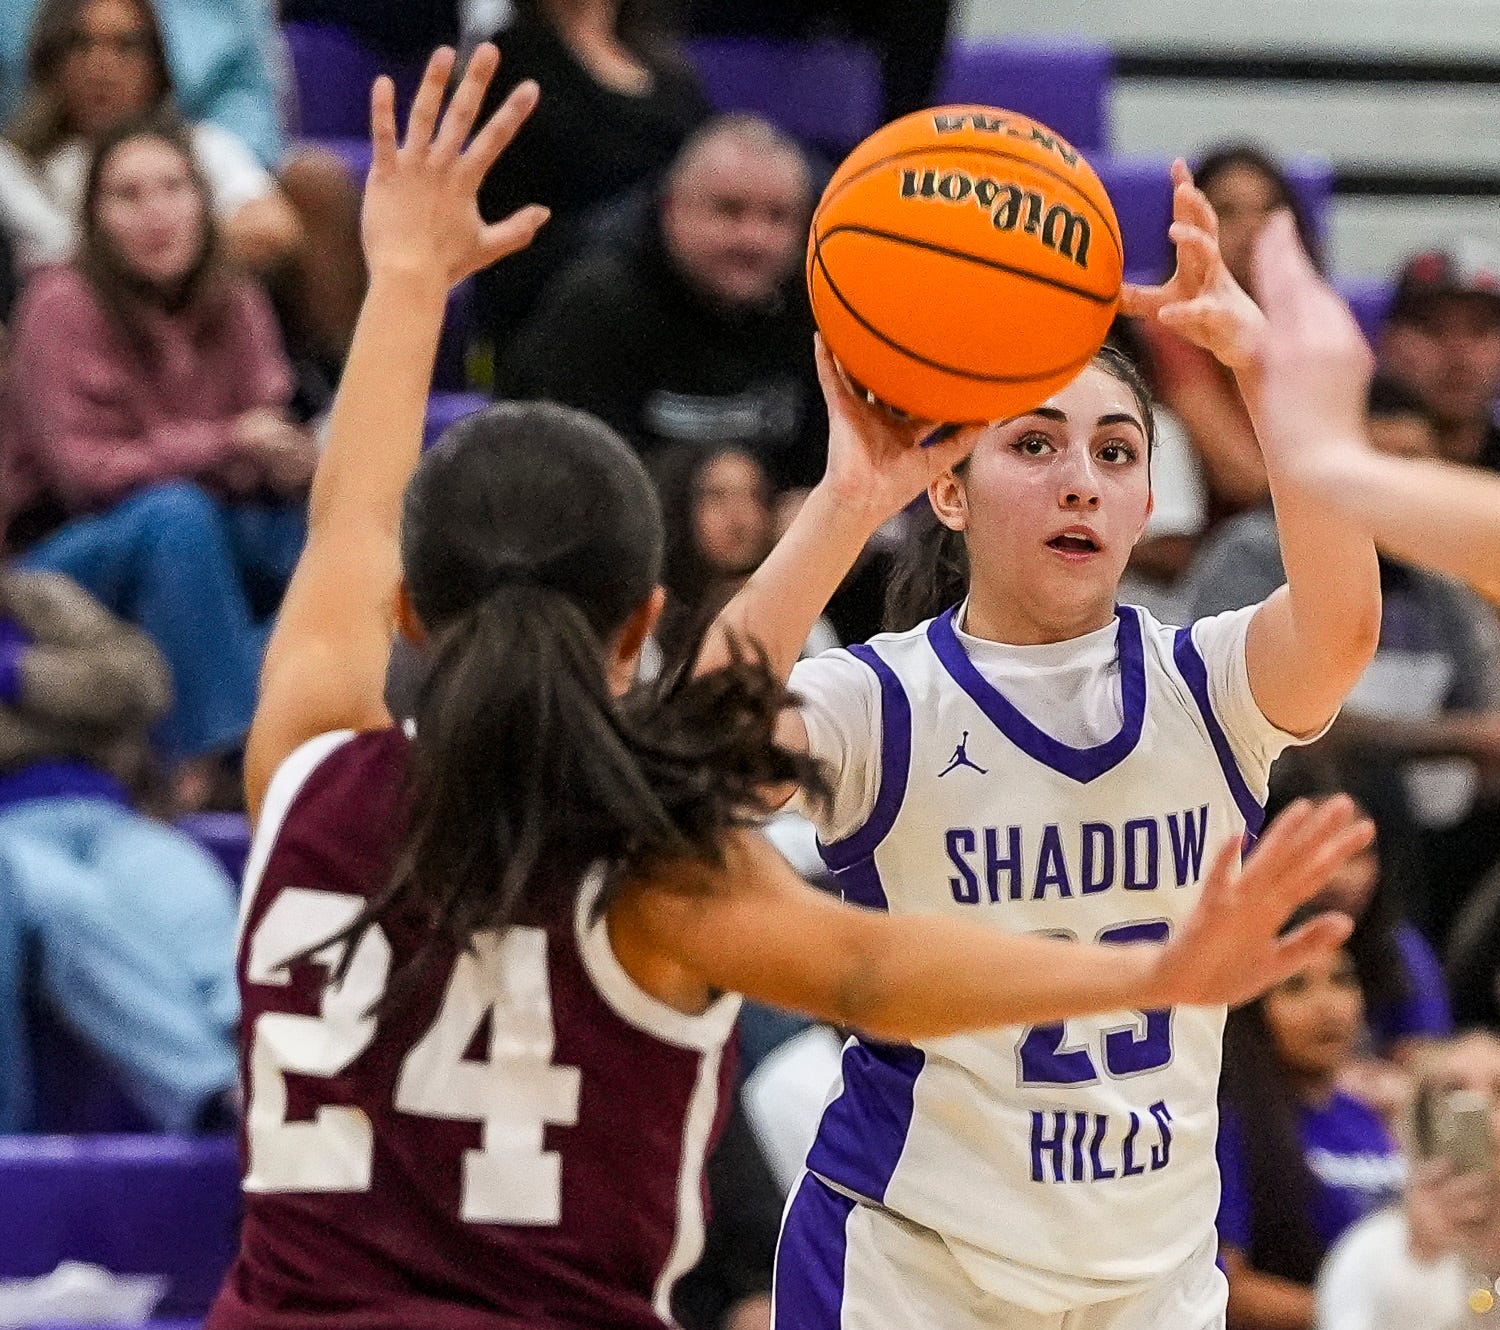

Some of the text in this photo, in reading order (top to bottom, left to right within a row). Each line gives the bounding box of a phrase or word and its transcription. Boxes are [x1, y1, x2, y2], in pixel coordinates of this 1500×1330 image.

[901, 169, 1091, 268] Wilson
[944, 803, 1210, 906] SHADOW
[241, 886, 583, 1228] 24
[1028, 1099, 1175, 1185] HILLS
